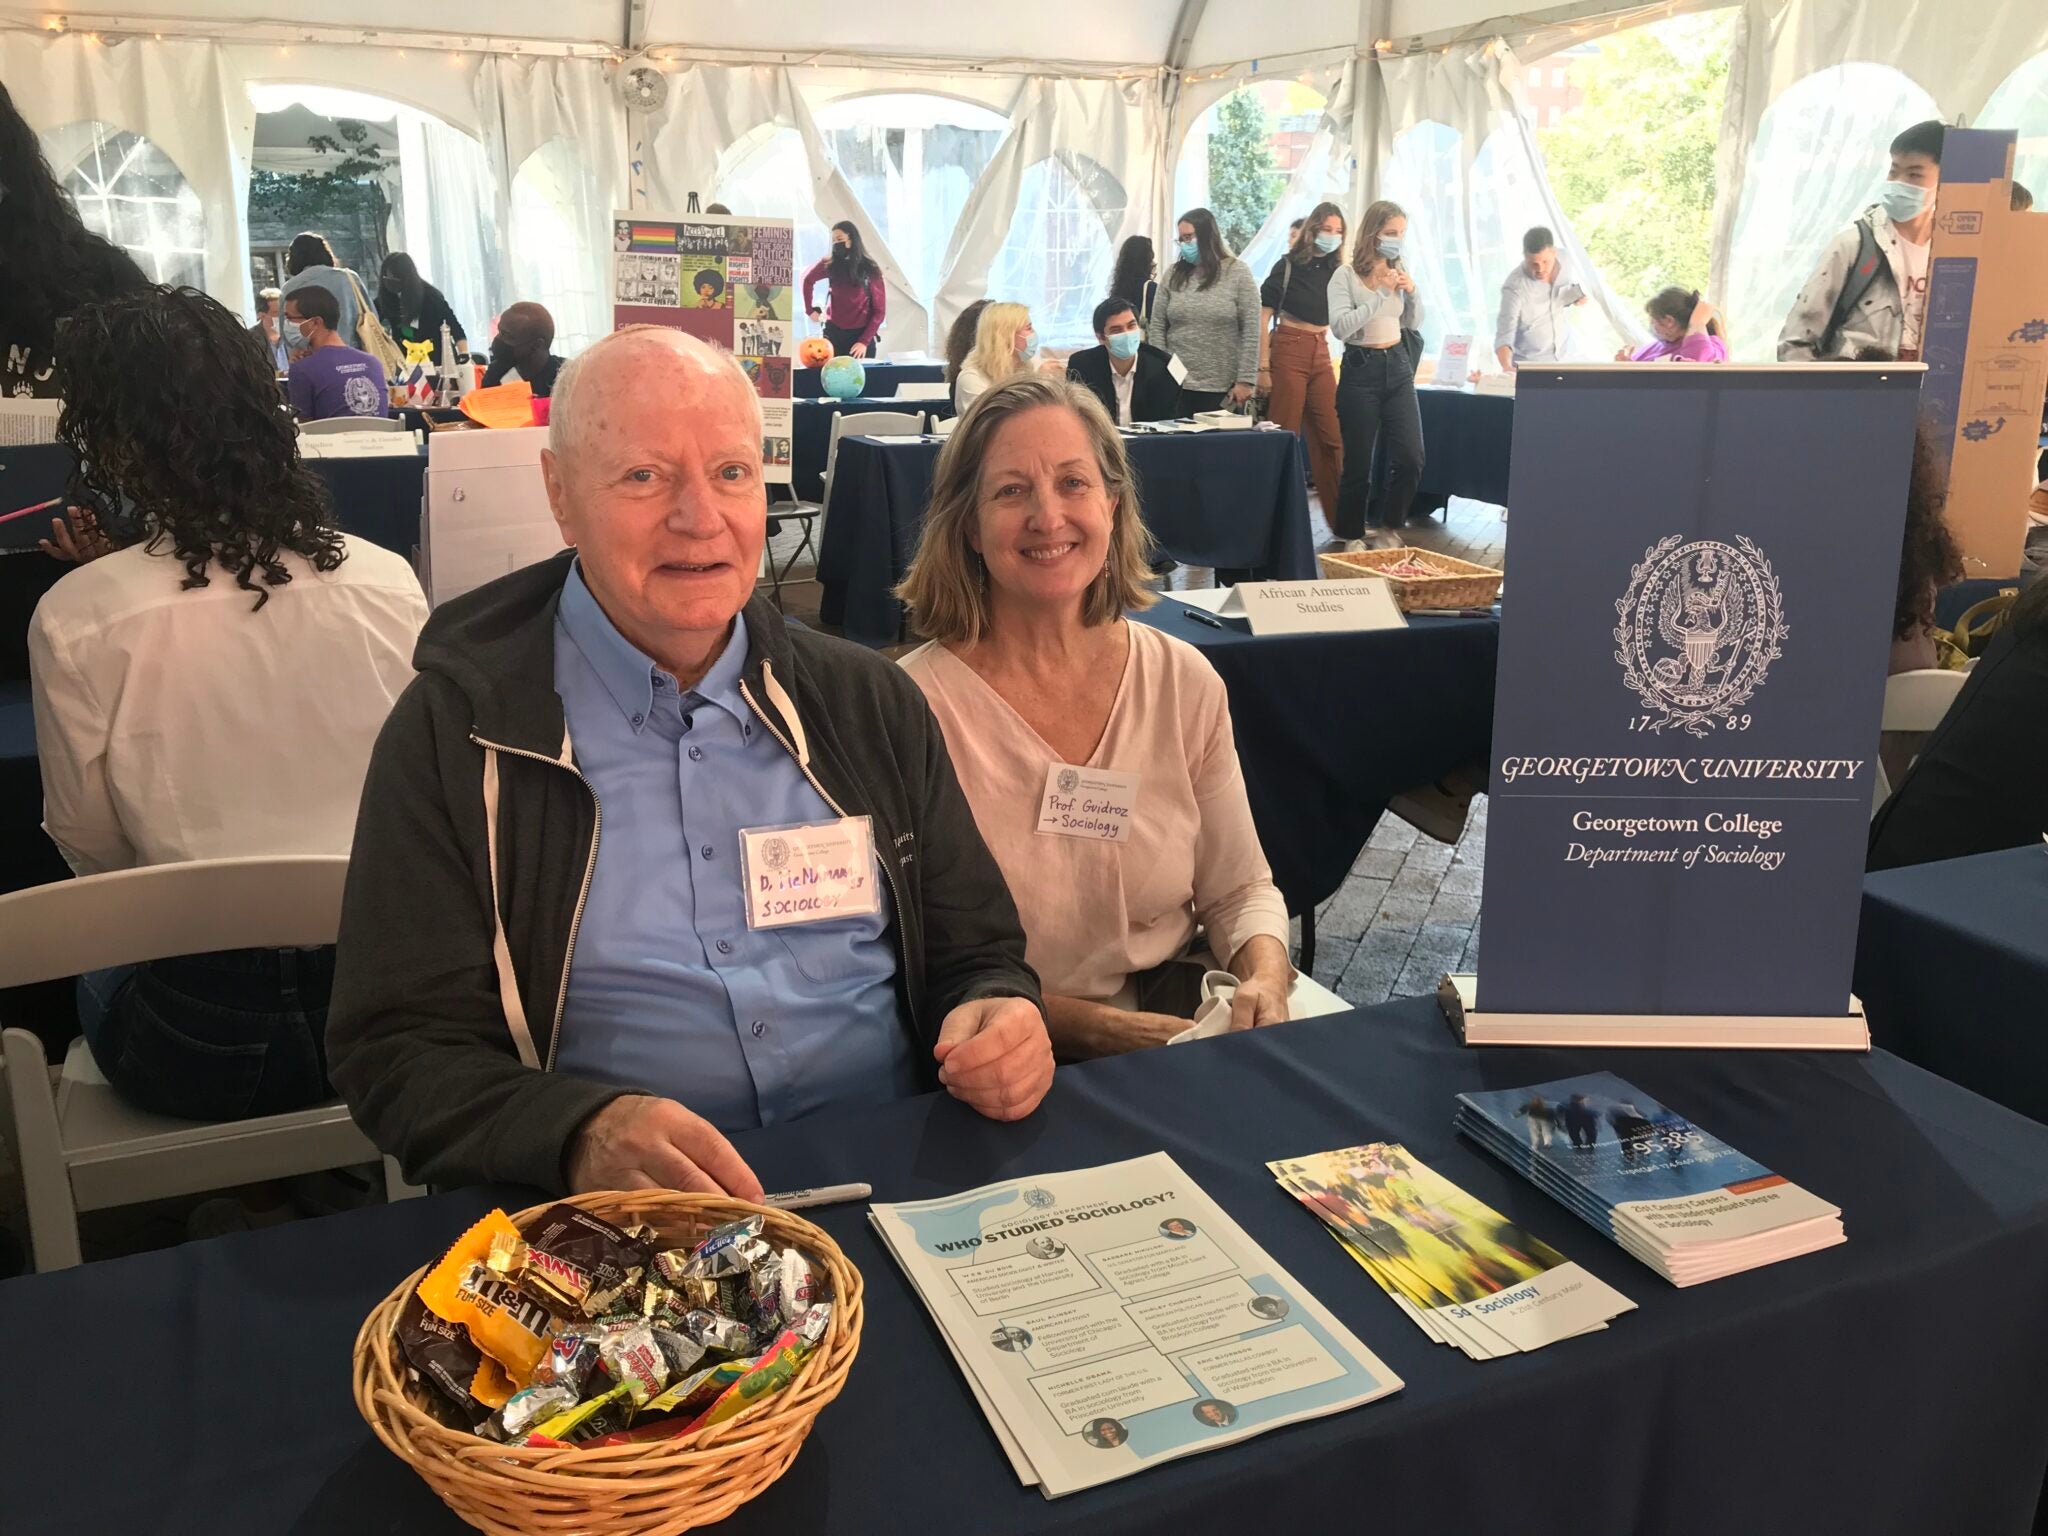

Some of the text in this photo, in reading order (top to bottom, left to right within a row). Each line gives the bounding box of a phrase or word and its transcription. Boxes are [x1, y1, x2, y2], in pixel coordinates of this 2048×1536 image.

[752, 226, 792, 239] FEMINIST
[752, 249, 792, 260] POLITICAL
[728, 276, 749, 284] RIGHTS
[752, 266, 792, 278] EQUALITY
[1258, 585, 1370, 600] African American
[1296, 602, 1344, 614] Studies
[1628, 714, 1752, 732] 17 89
[1502, 757, 1864, 784] GEORGETOWN UNIVERSITY
[1049, 794, 1128, 818] Prof. Guidroz
[1062, 814, 1119, 838] Sociology
[1572, 811, 1783, 838] Georgetown College
[1564, 843, 1786, 870] Department of Sociology
[1002, 1200, 1109, 1228] SOCIOLOGY DEPARTMENT
[1630, 1194, 1728, 1214] 21st Century Careers
[1644, 1192, 1781, 1220] with an Undergraduate Degree
[934, 1191, 1176, 1252] WHO STUDIED SOCIOLOGY?
[1653, 1218, 1714, 1229] in Sociology
[526, 1248, 588, 1294] Twix
[1114, 1264, 1150, 1276] Graduated
[1151, 1260, 1164, 1268] with
[1119, 1270, 1150, 1280] sociology
[972, 1268, 1070, 1294] Studied sociology Harvard
[976, 1288, 1010, 1299] University
[1012, 1284, 1026, 1292] and
[1040, 1272, 1074, 1285] University
[456, 1288, 498, 1318] FUN SIZE
[990, 1294, 1010, 1302] Berlin
[1475, 1286, 1541, 1314] Sociology
[1518, 1303, 1534, 1313] 21st
[1535, 1292, 1562, 1308] Century
[1562, 1282, 1584, 1296] Major
[1032, 1313, 1090, 1332] AMERICAN ACTIVIST
[1152, 1318, 1188, 1330] Graduated
[1226, 1303, 1240, 1311] with
[1176, 1319, 1209, 1330] sociology
[420, 1318, 438, 1332] FUN
[438, 1326, 458, 1342] SIZE
[1038, 1324, 1090, 1341] Fellowshipped
[1090, 1320, 1104, 1328] with
[1193, 1323, 1220, 1333] College
[1042, 1336, 1078, 1347] University
[1046, 1338, 1090, 1352] Department
[1050, 1346, 1086, 1358] Sociology
[1048, 1370, 1112, 1390] MICHELLE OBAMA
[1212, 1368, 1250, 1382] Graduated
[1218, 1375, 1251, 1388] sociology
[1252, 1370, 1270, 1378] from
[1282, 1356, 1318, 1370] University
[1053, 1388, 1080, 1398] FORMER
[1060, 1378, 1156, 1408] Graduated cum laude with
[1232, 1376, 1276, 1392] Washington
[1064, 1408, 1078, 1416] BA
[1086, 1396, 1122, 1410] sociology
[1123, 1389, 1142, 1398] from
[1068, 1396, 1145, 1421] Princeton University
